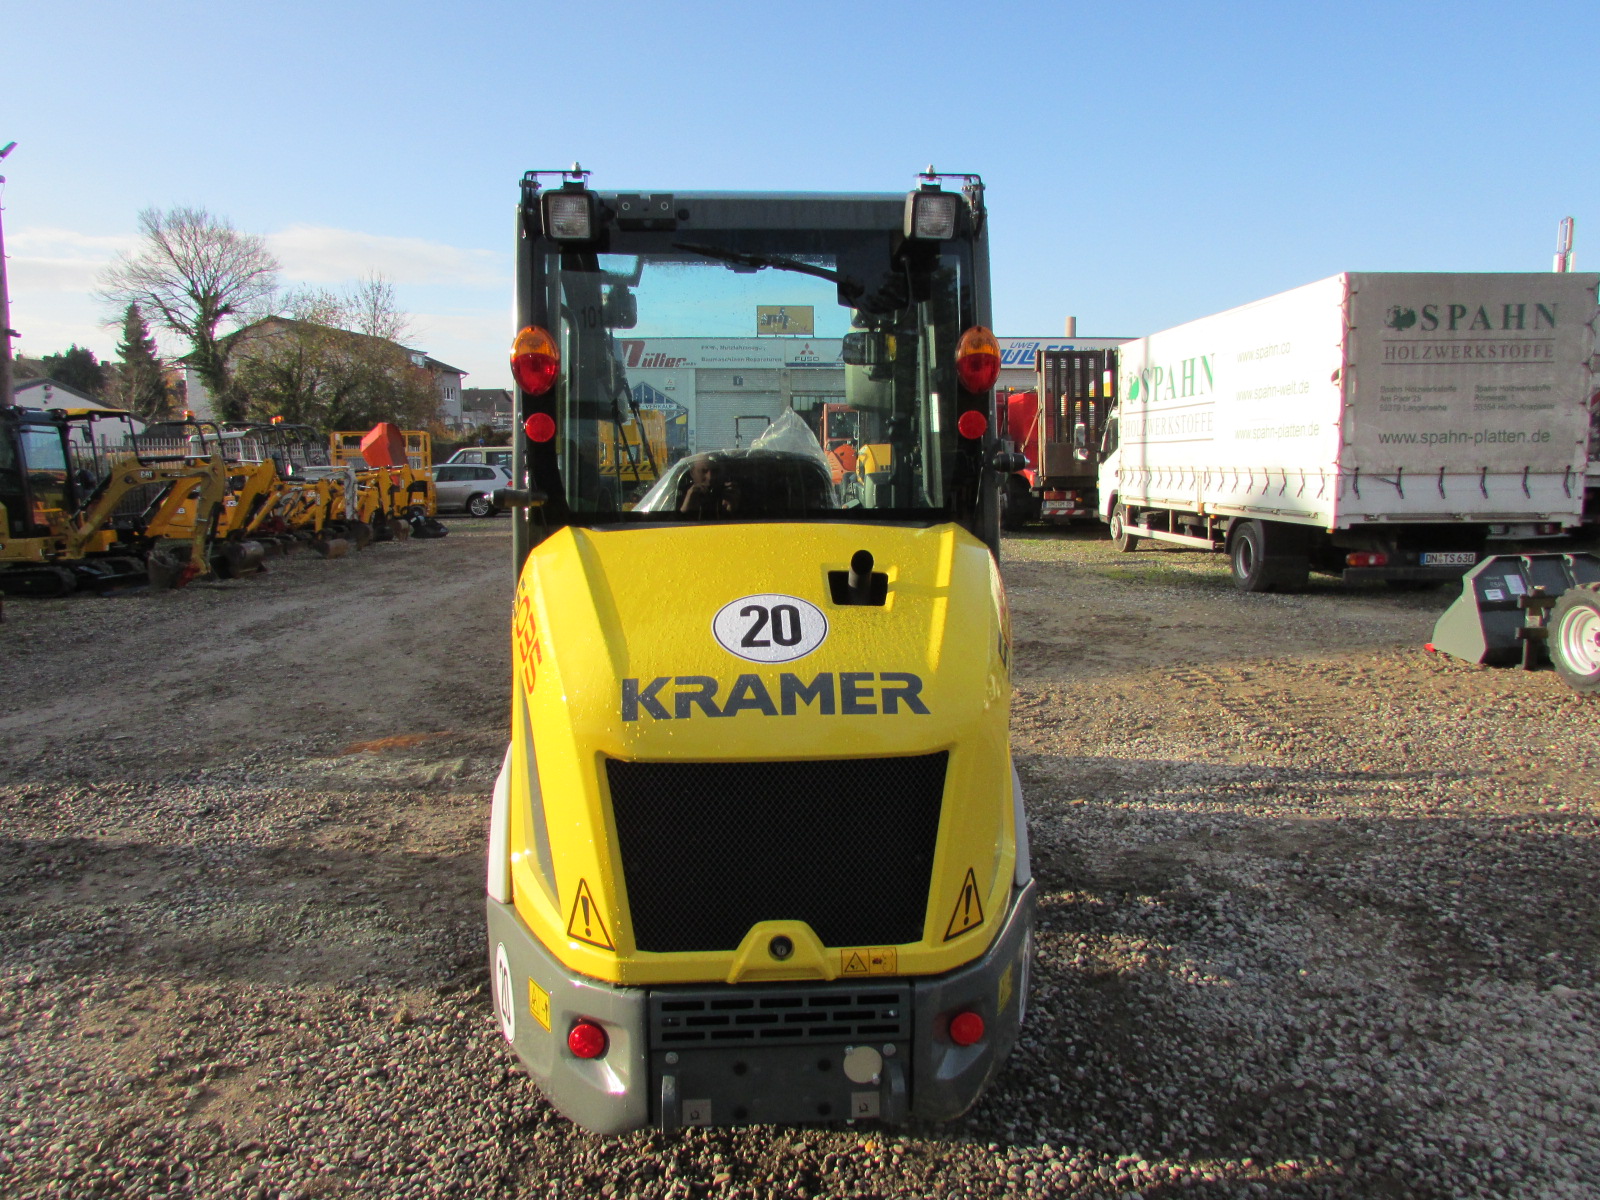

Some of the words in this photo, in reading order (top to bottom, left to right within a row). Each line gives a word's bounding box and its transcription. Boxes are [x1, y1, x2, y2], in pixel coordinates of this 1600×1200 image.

[1420, 303, 1558, 332] SPAHN
[1009, 341, 1034, 349] UWE
[1384, 344, 1554, 361] HOLZWERKSTOFFE
[1141, 352, 1215, 404] SPAHN
[1236, 380, 1310, 402] www.spahn-welt.de
[1124, 411, 1214, 438] HOLZWERKSTOFFE
[1235, 421, 1319, 442] www.spahn-platten.de
[1378, 429, 1551, 447] www.spahn-platten.de
[1425, 553, 1438, 563] DN
[1443, 553, 1455, 563] TS
[1456, 553, 1474, 563] 630
[739, 604, 803, 648] 20
[621, 671, 932, 722] KRAMER
